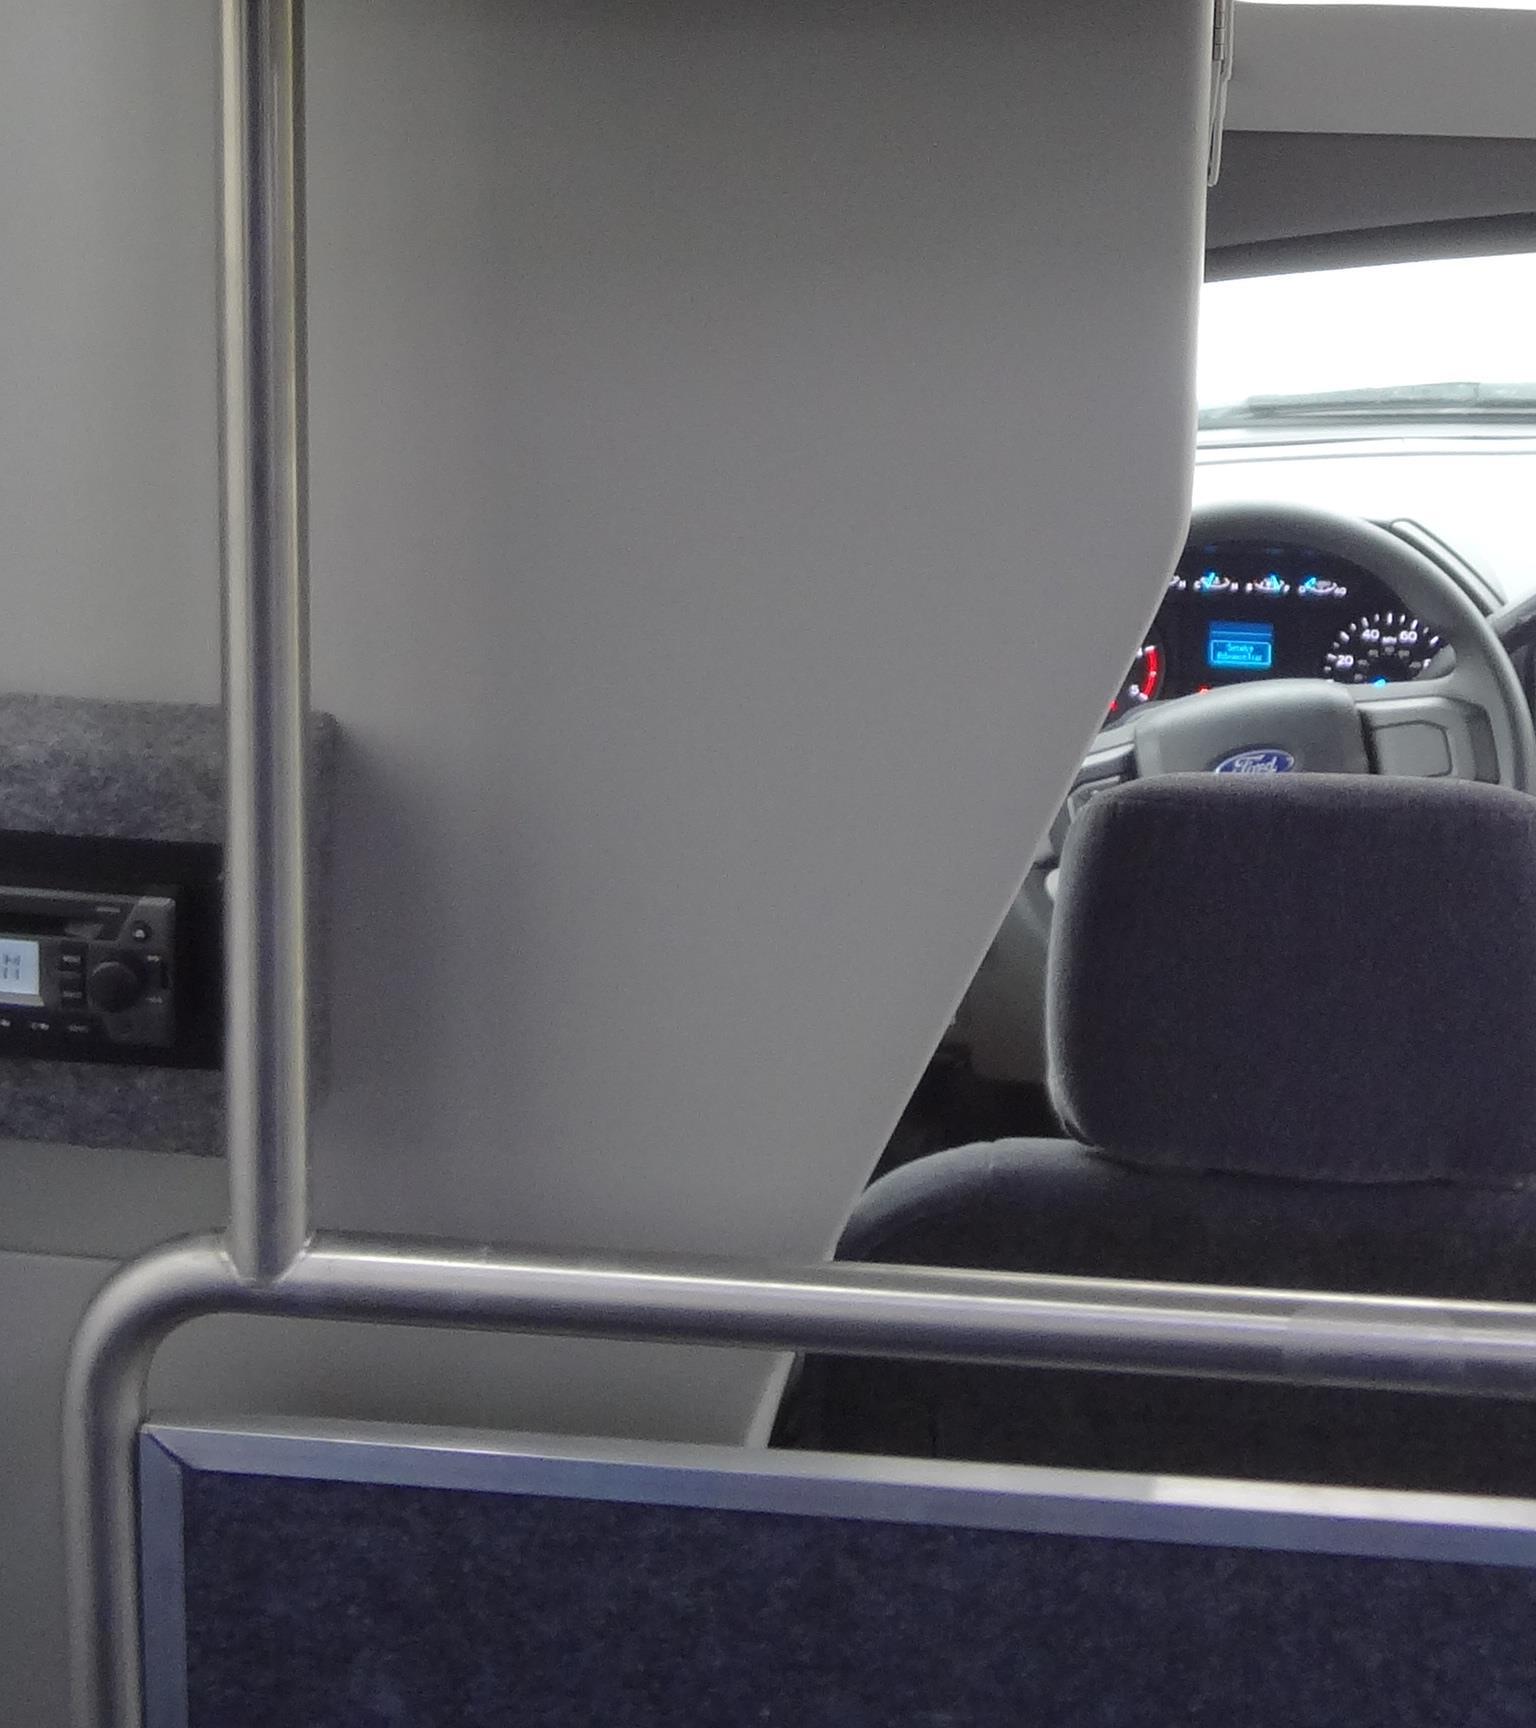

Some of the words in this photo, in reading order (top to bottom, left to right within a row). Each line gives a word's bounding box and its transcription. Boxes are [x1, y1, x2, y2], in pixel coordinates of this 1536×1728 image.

[1362, 629, 1380, 641] 40
[1399, 630, 1418, 642] 60
[1337, 655, 1354, 667] 20
